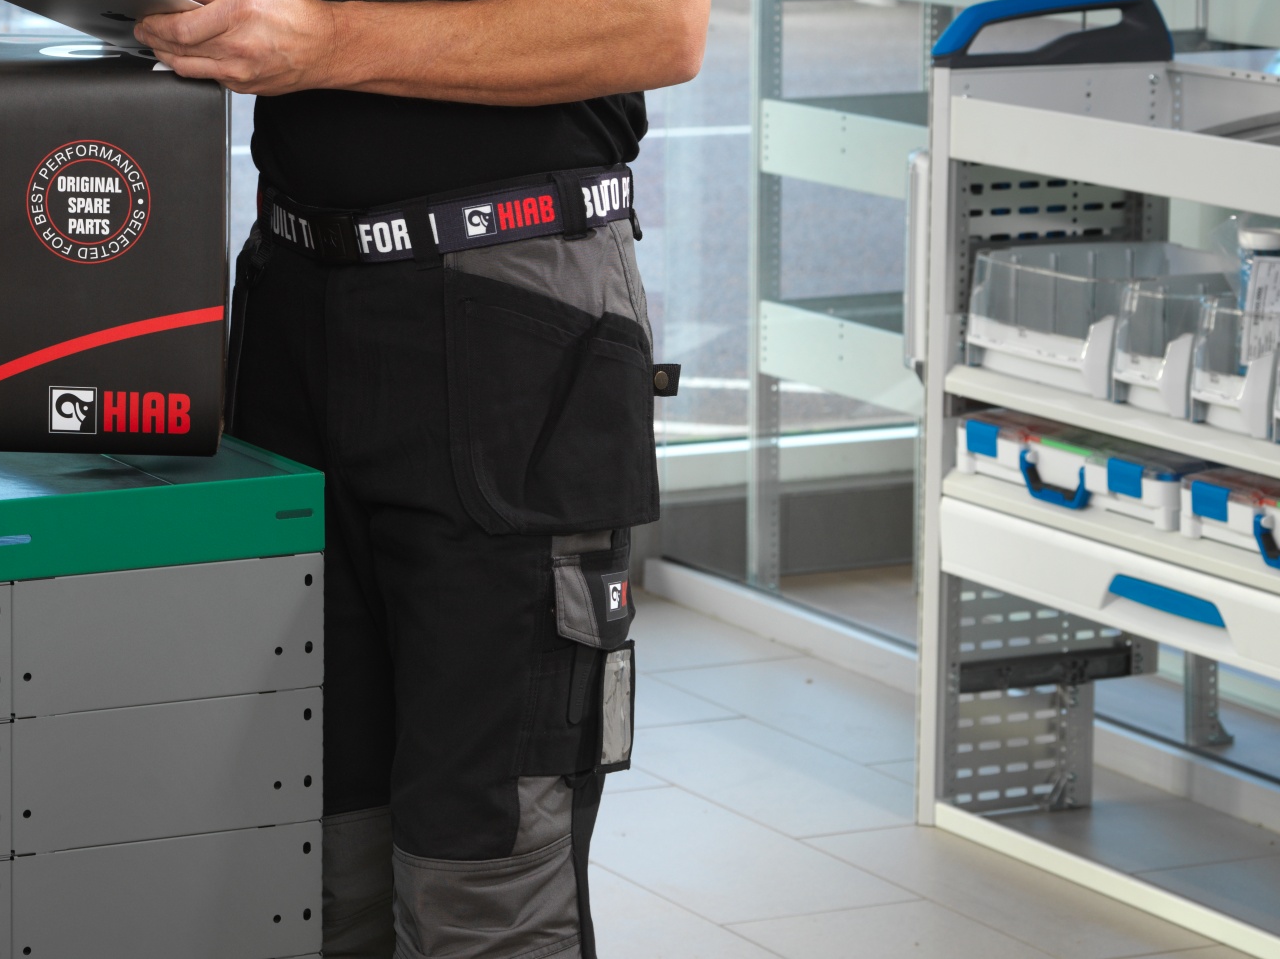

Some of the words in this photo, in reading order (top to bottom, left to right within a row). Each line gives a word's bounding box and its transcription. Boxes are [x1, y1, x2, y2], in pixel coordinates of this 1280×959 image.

[38, 144, 146, 193] PERFORMANCE
[57, 175, 122, 193] ORIGINAL
[31, 182, 47, 226] BEST
[67, 197, 111, 214] SPARE
[271, 203, 298, 243] UILT
[497, 194, 556, 231] HIAB
[42, 227, 73, 256] FOR
[67, 218, 111, 235] PARTS
[77, 209, 146, 260] SELECTED
[103, 390, 191, 435] HIAB
